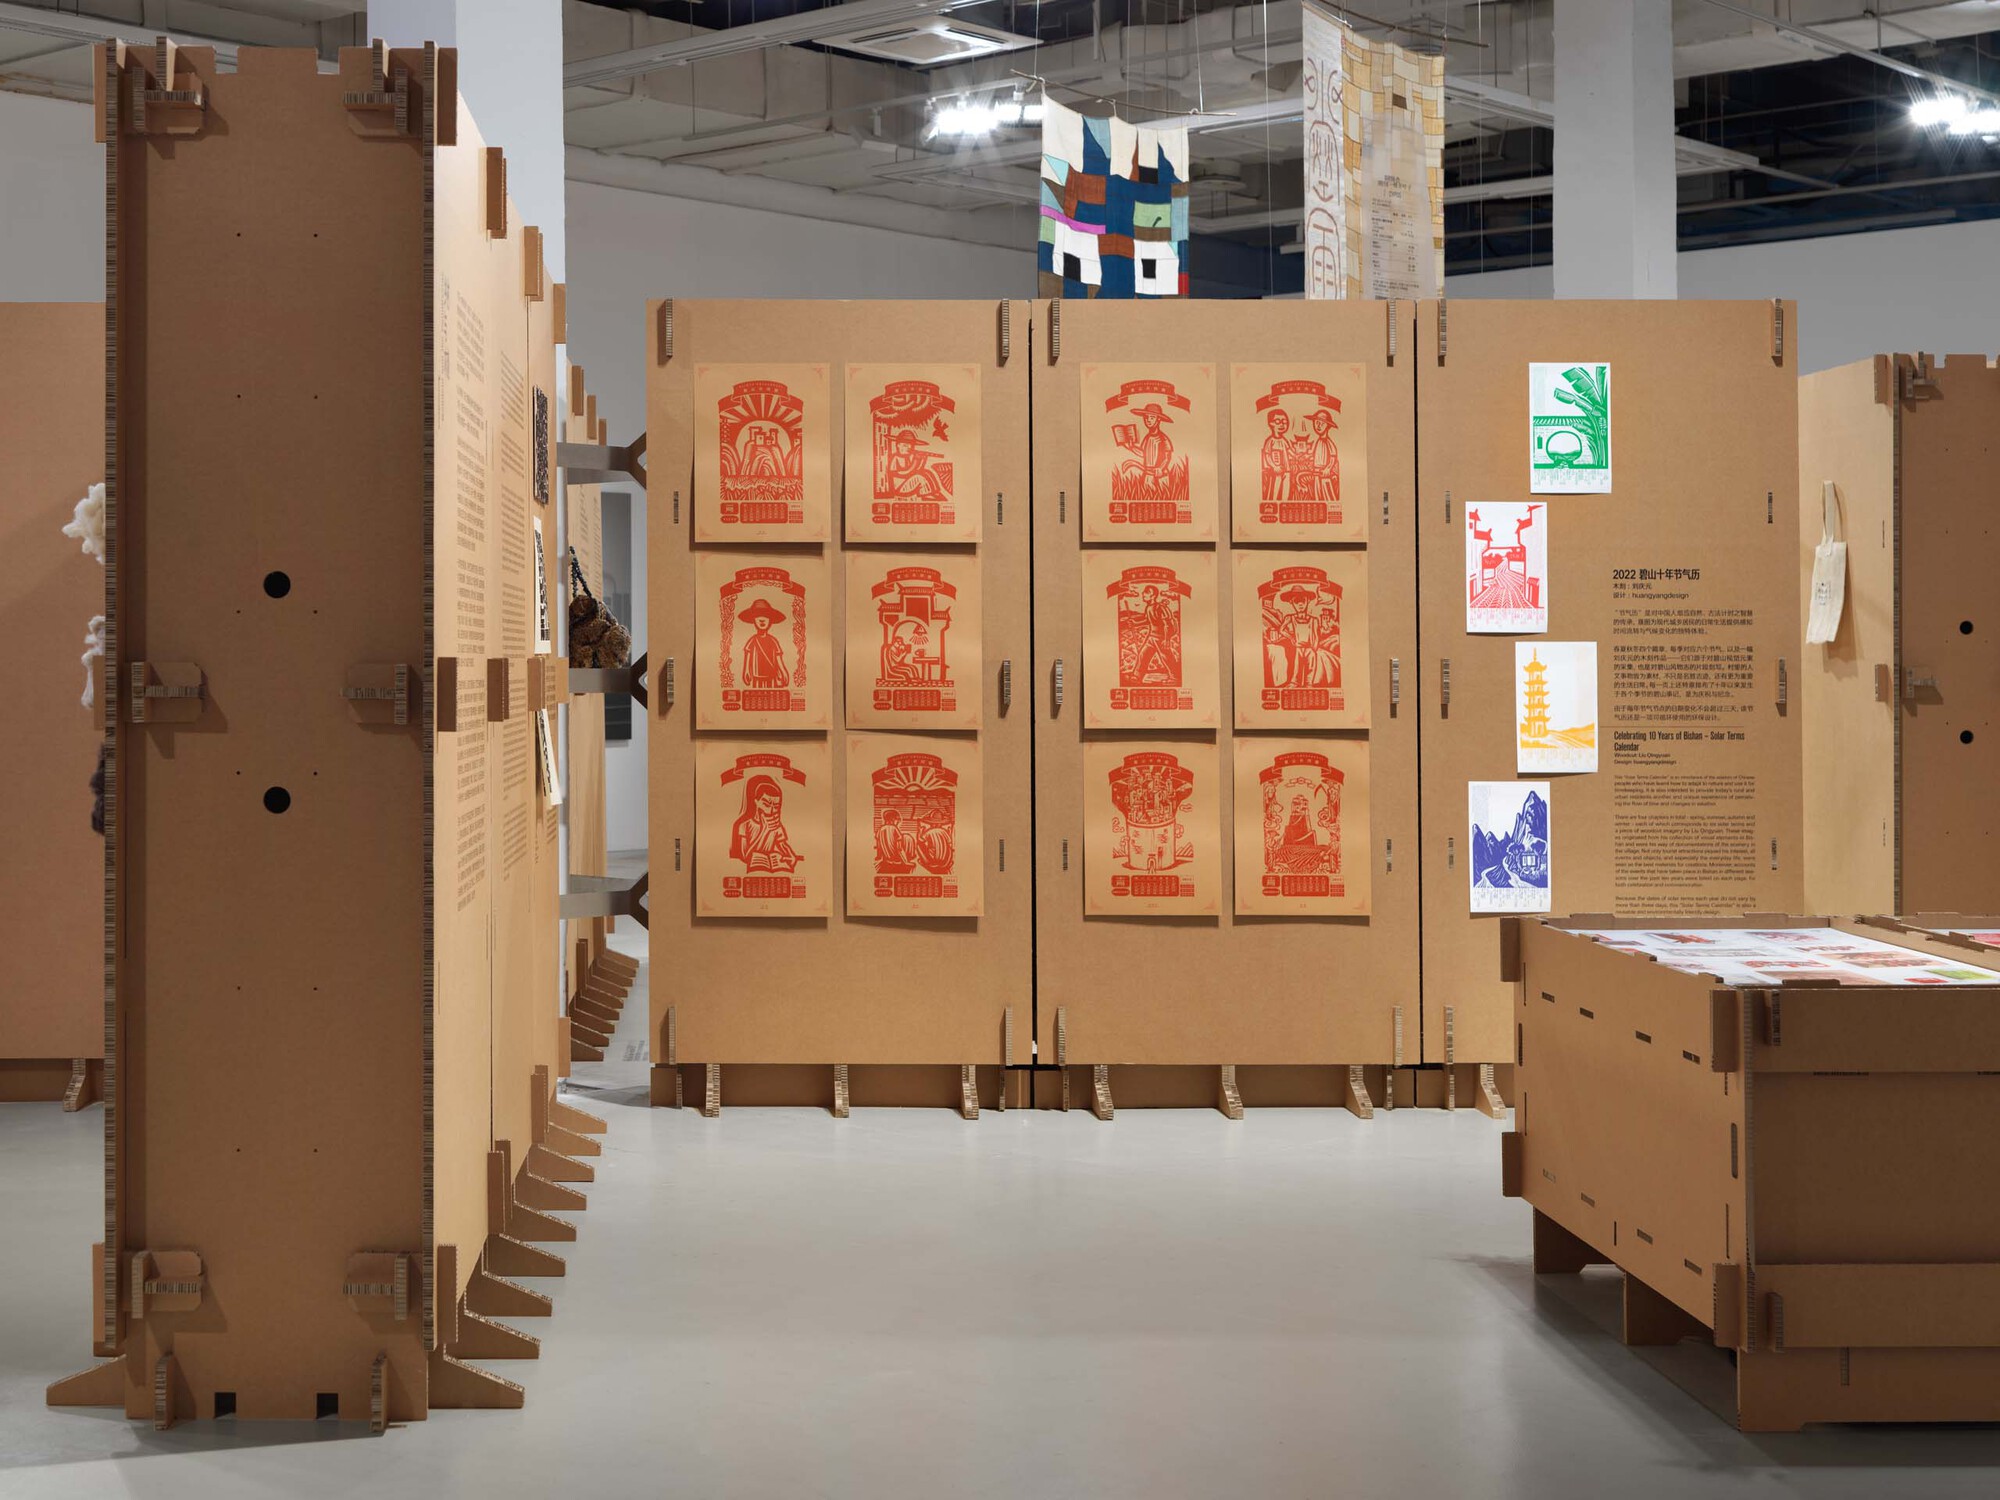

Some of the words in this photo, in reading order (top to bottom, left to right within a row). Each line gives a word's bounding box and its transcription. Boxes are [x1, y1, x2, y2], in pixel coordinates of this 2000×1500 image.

[1613, 569, 1636, 579] 2022
[1639, 568, 1700, 580] 碧山十年节气历
[1614, 731, 1647, 741] Celebrating
[1649, 731, 1656, 740] 10
[1658, 731, 1674, 740] Years
[1676, 731, 1682, 740] of
[1684, 731, 1702, 740] Bishan
[1710, 731, 1725, 740] Solar
[1727, 731, 1745, 740] Terms
[1614, 742, 1639, 751] Calendar
